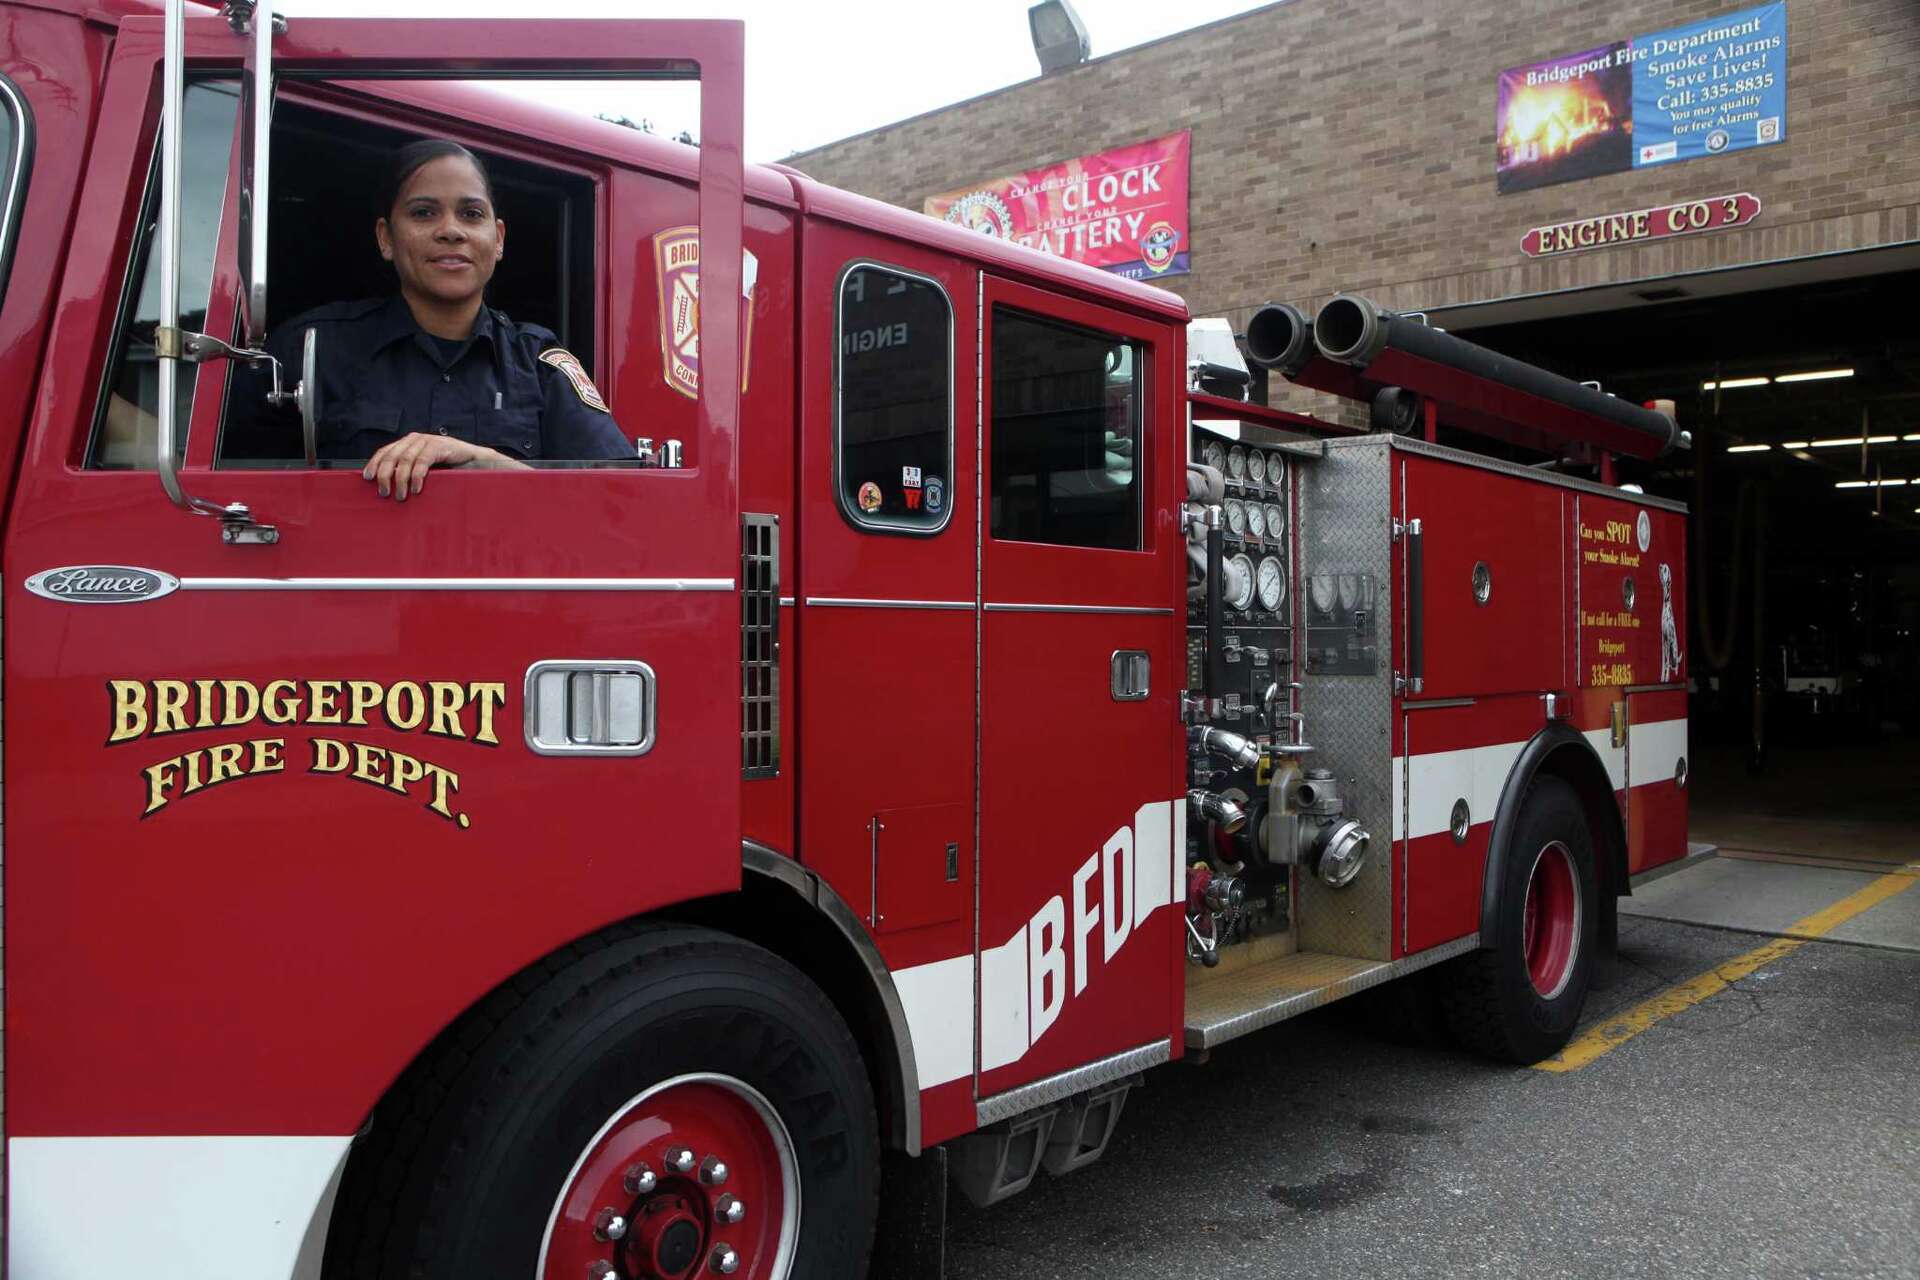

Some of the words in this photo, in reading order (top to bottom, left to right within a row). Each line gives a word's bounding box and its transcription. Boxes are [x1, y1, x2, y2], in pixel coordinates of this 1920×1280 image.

[1526, 58, 1612, 86] Bridgeport
[1615, 46, 1649, 66] Fire
[1653, 16, 1761, 55] Department
[1647, 51, 1709, 78] Smoke
[1713, 35, 1781, 61] Alarms
[1664, 70, 1707, 91] Save
[1712, 53, 1767, 81] Lives!
[1657, 90, 1695, 111] Call:
[1700, 73, 1774, 103] 335-8835
[1670, 109, 1691, 121] You
[1693, 105, 1717, 117] may
[1720, 94, 1761, 113] qualify
[1672, 124, 1689, 135] for
[1692, 120, 1713, 132] free
[1717, 110, 1760, 126] Alarms
[1062, 164, 1162, 212] CLOCK
[1036, 214, 1081, 231] CHANGE
[1087, 205, 1118, 221] YOUR
[1538, 211, 1651, 253] ENGINE
[1668, 202, 1710, 231] CO
[1722, 197, 1740, 224] 3
[1579, 522, 1593, 539] Can
[1593, 529, 1605, 544] you
[1606, 519, 1632, 545] SPOT
[1583, 551, 1599, 565] your
[1600, 548, 1619, 565] Smoke
[49, 568, 150, 594] Lance
[1591, 663, 1633, 687] 335-8835
[105, 678, 506, 748] BRIDGEPORT
[139, 737, 286, 821] FIRE
[308, 737, 471, 831] DEPT.
[1029, 824, 1135, 1049] BFD
